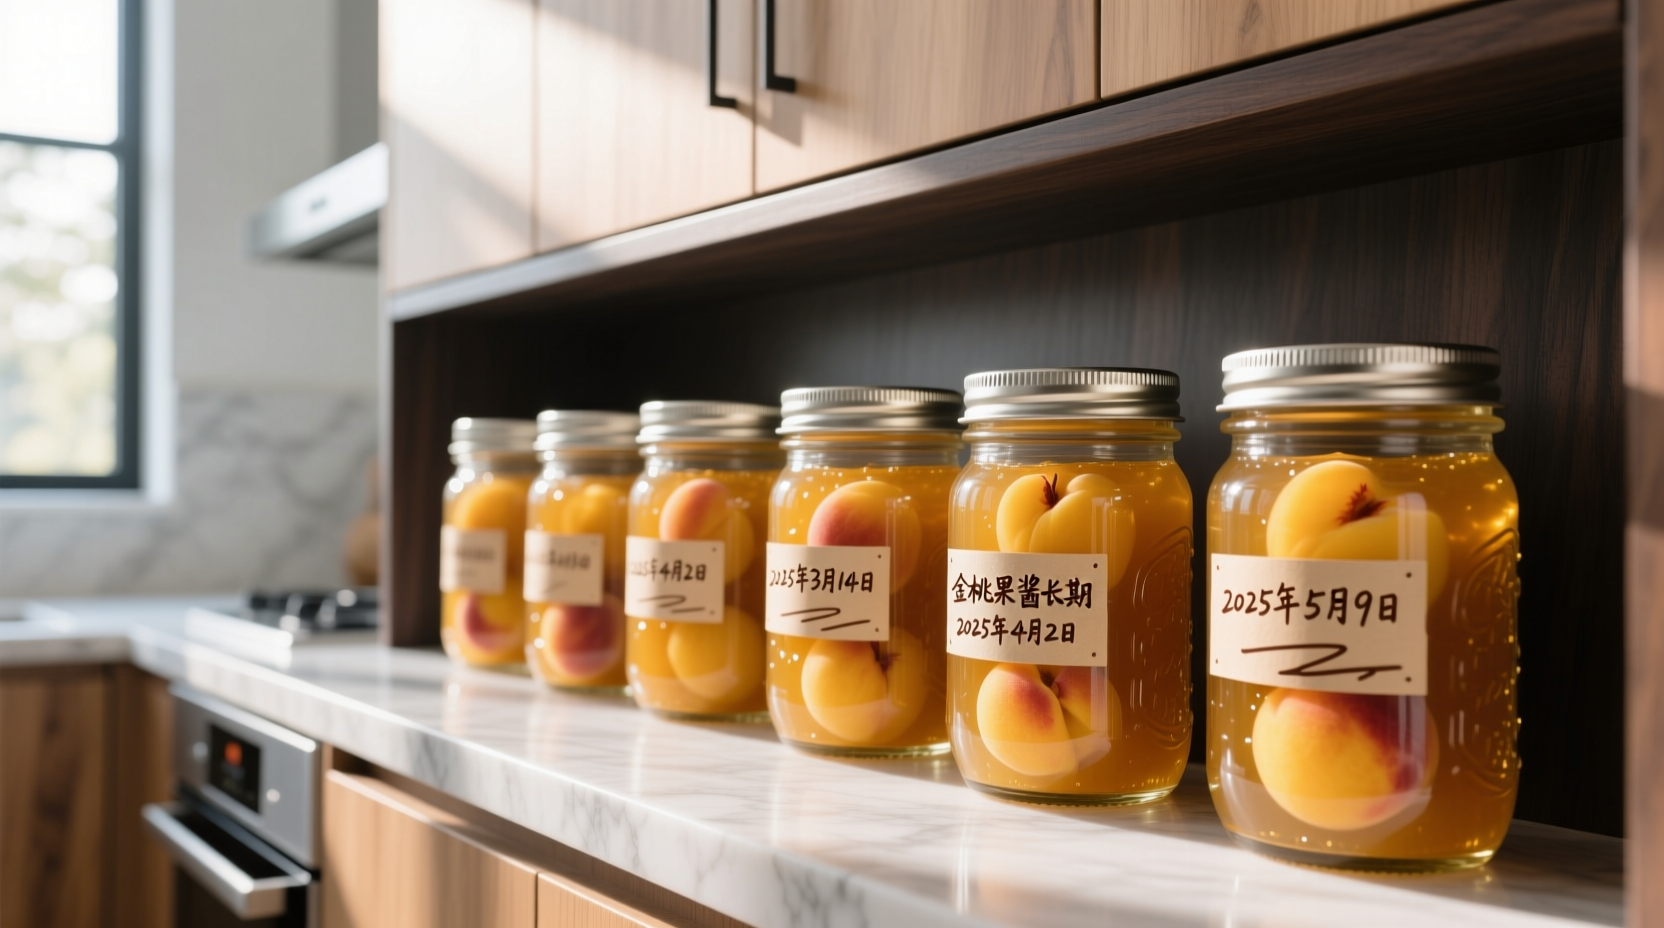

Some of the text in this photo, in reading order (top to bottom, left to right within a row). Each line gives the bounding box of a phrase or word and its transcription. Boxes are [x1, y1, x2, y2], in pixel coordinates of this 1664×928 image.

[630, 558, 707, 581] 5年4月2日
[951, 572, 1092, 609] 金桃果酱长期
[1221, 582, 1398, 627] 2025年5月9日
[956, 614, 1075, 646] 2025年4月2日
